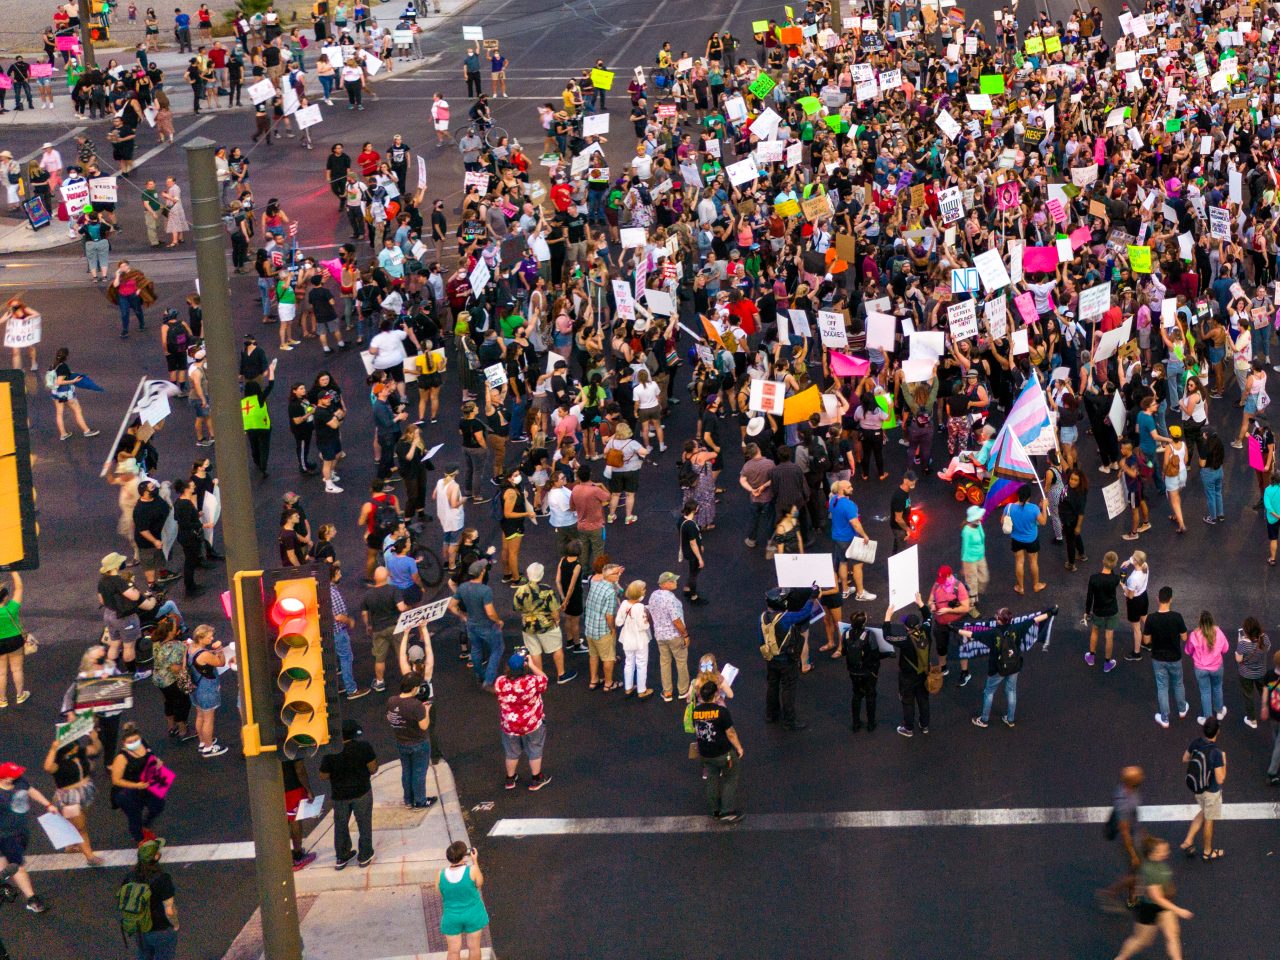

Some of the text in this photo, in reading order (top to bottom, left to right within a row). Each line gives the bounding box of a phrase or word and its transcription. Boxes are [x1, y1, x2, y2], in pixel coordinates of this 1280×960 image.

[953, 269, 979, 291] NO
[949, 303, 967, 313] PUBLIC
[823, 330, 844, 338] BODIES
[401, 599, 448, 622] JUSTICE
[693, 710, 719, 720] BURN
